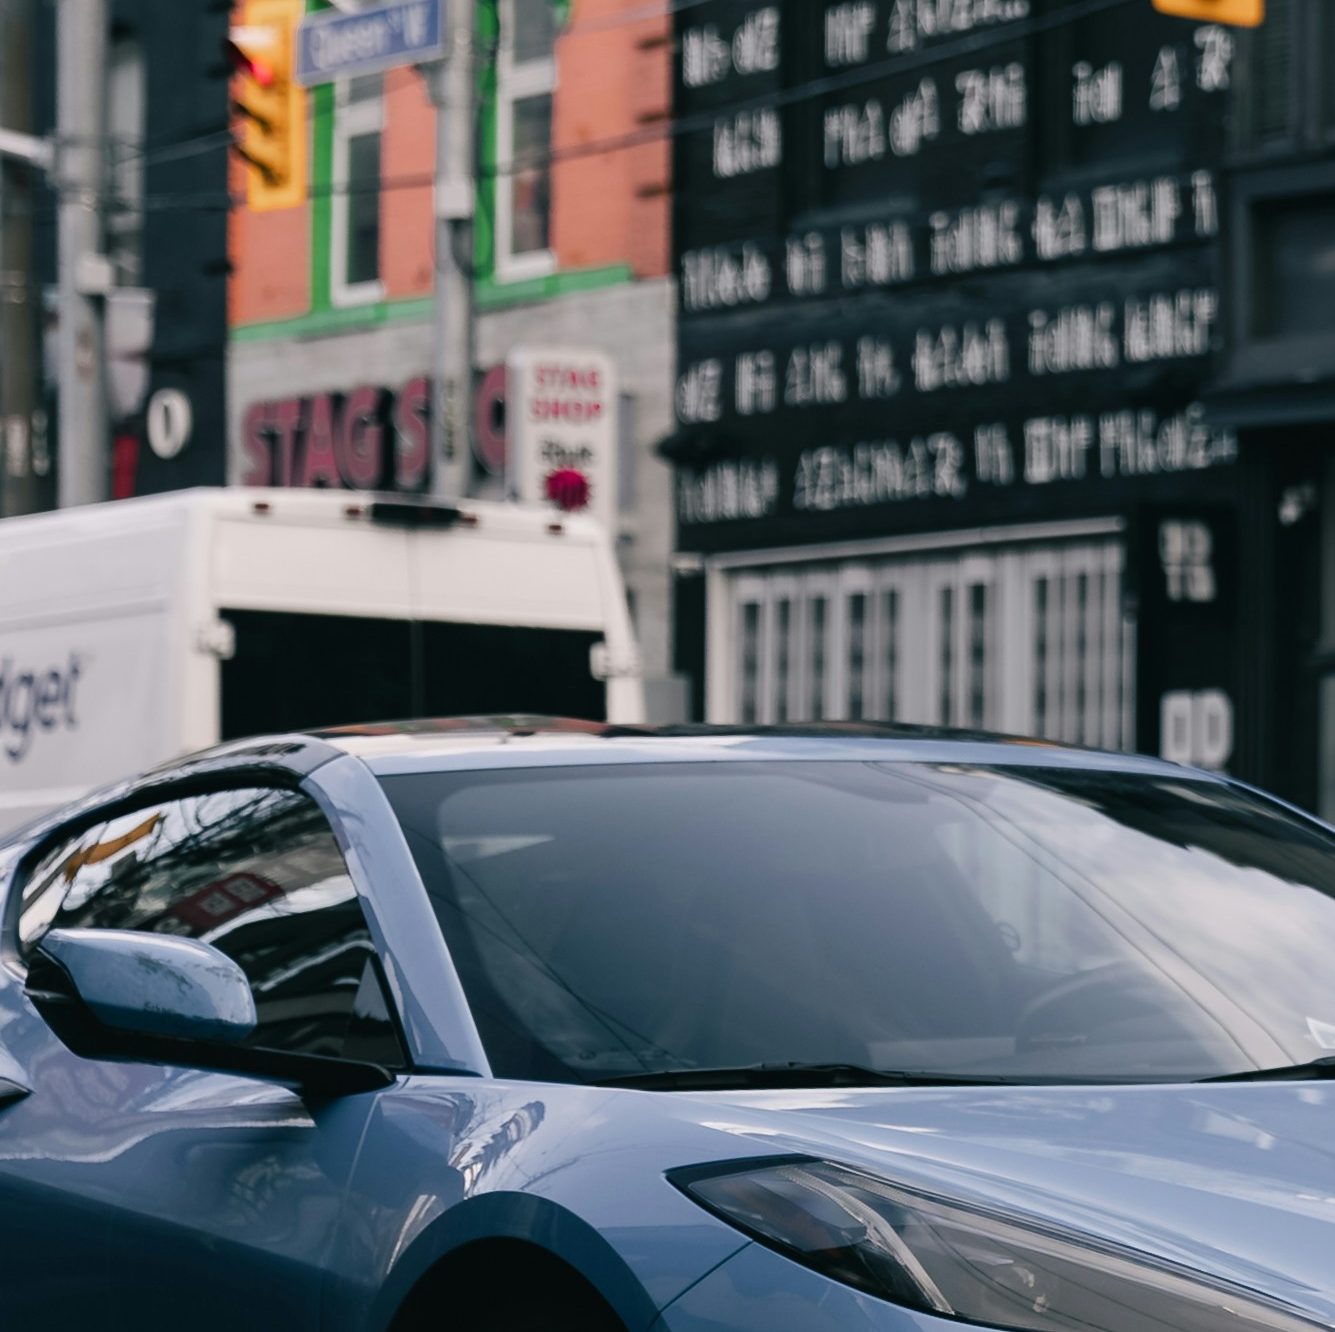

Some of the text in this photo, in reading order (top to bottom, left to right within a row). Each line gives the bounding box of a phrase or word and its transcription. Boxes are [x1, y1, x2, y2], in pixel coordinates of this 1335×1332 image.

[404, 4, 430, 49] W
[531, 396, 603, 423] SHOP
[243, 384, 384, 488] STAG
